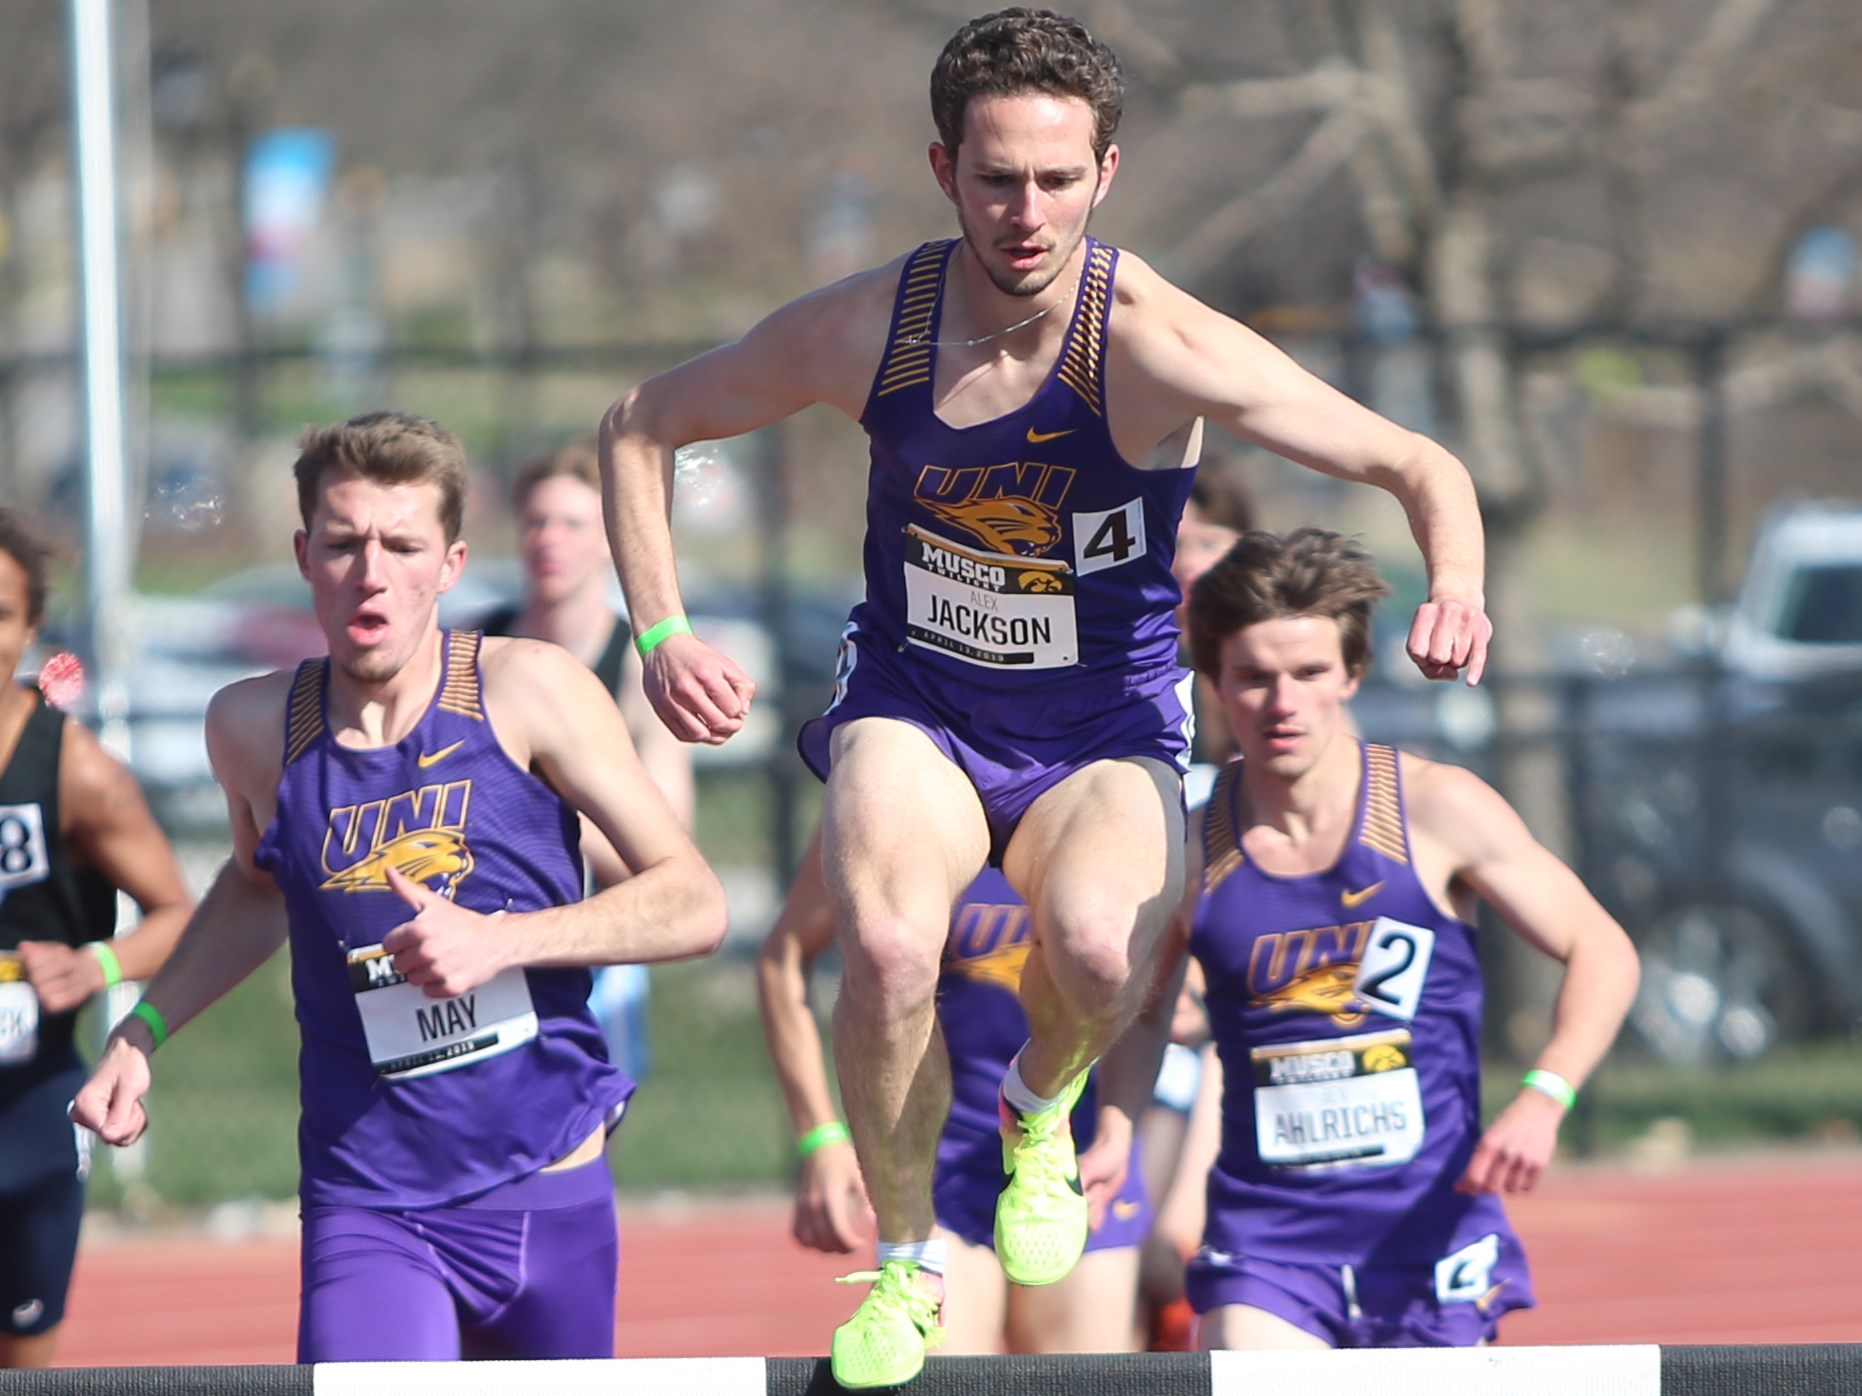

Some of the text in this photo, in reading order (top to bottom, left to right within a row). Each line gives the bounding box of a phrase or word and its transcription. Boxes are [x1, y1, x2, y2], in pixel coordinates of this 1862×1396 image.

[914, 461, 1076, 510] UNI
[1083, 508, 1136, 562] 4
[922, 542, 1006, 586] MUSCO
[928, 594, 1051, 646] JACKSON
[970, 590, 999, 612] ALEX
[924, 628, 955, 647] APRIL
[0, 817, 32, 874] 8
[321, 779, 472, 875] UNI
[1360, 929, 1417, 1007] 2
[416, 994, 477, 1042] MAY
[1274, 1100, 1407, 1148] AHLRICHS
